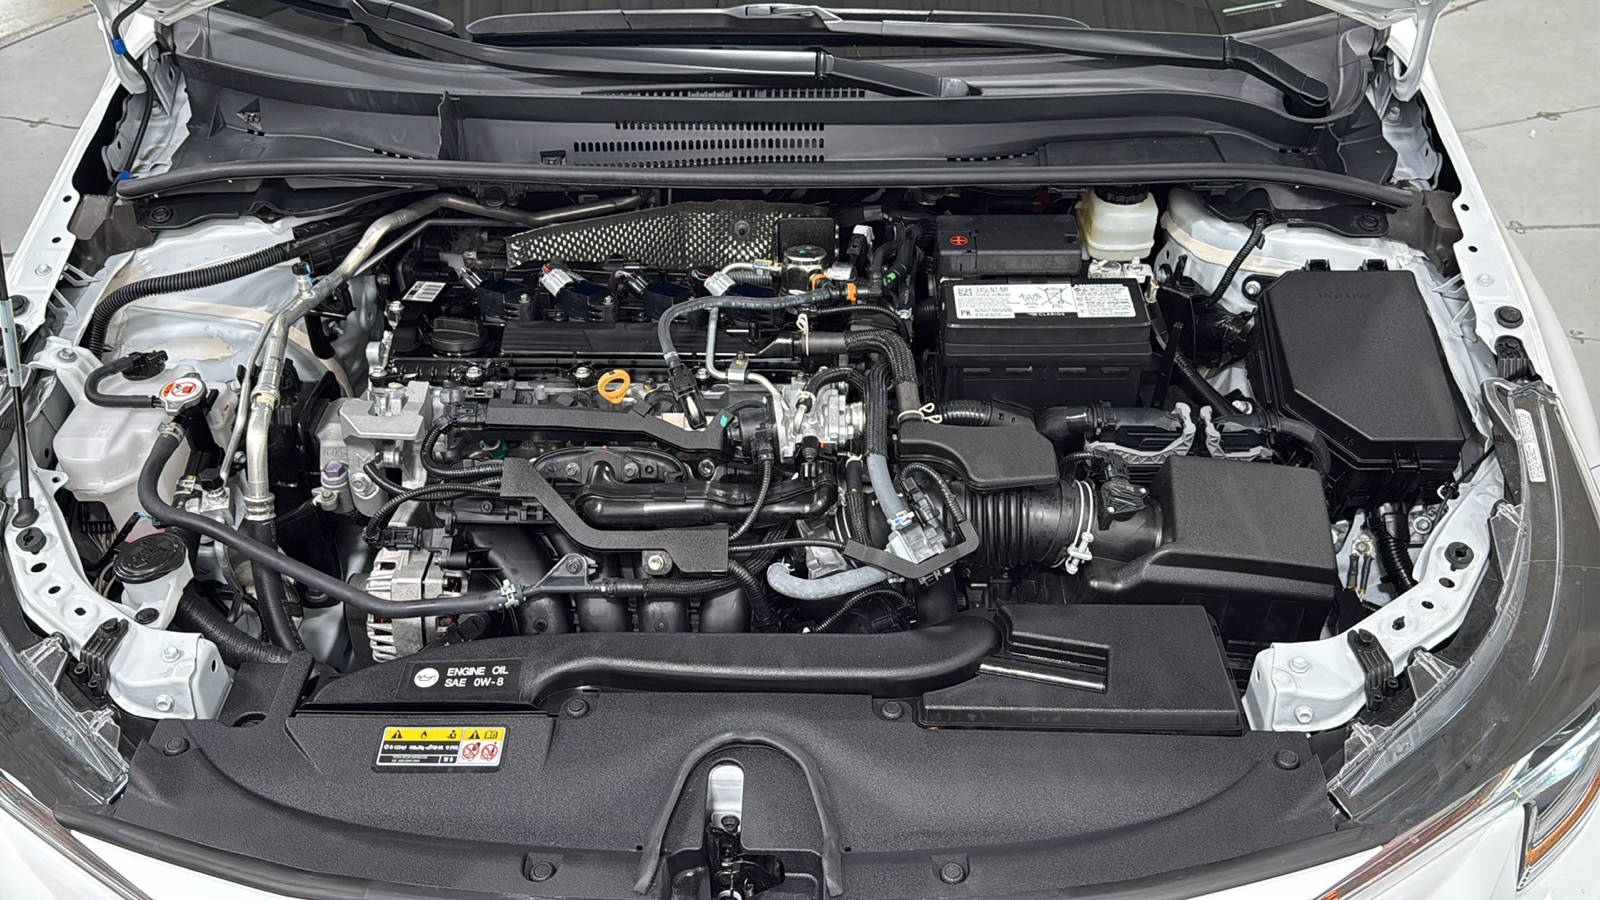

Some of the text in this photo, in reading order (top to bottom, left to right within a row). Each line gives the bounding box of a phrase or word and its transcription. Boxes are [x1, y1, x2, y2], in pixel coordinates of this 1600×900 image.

[447, 665, 509, 677] ENGINE OIL
[444, 677, 504, 688] SAE 0W-8
